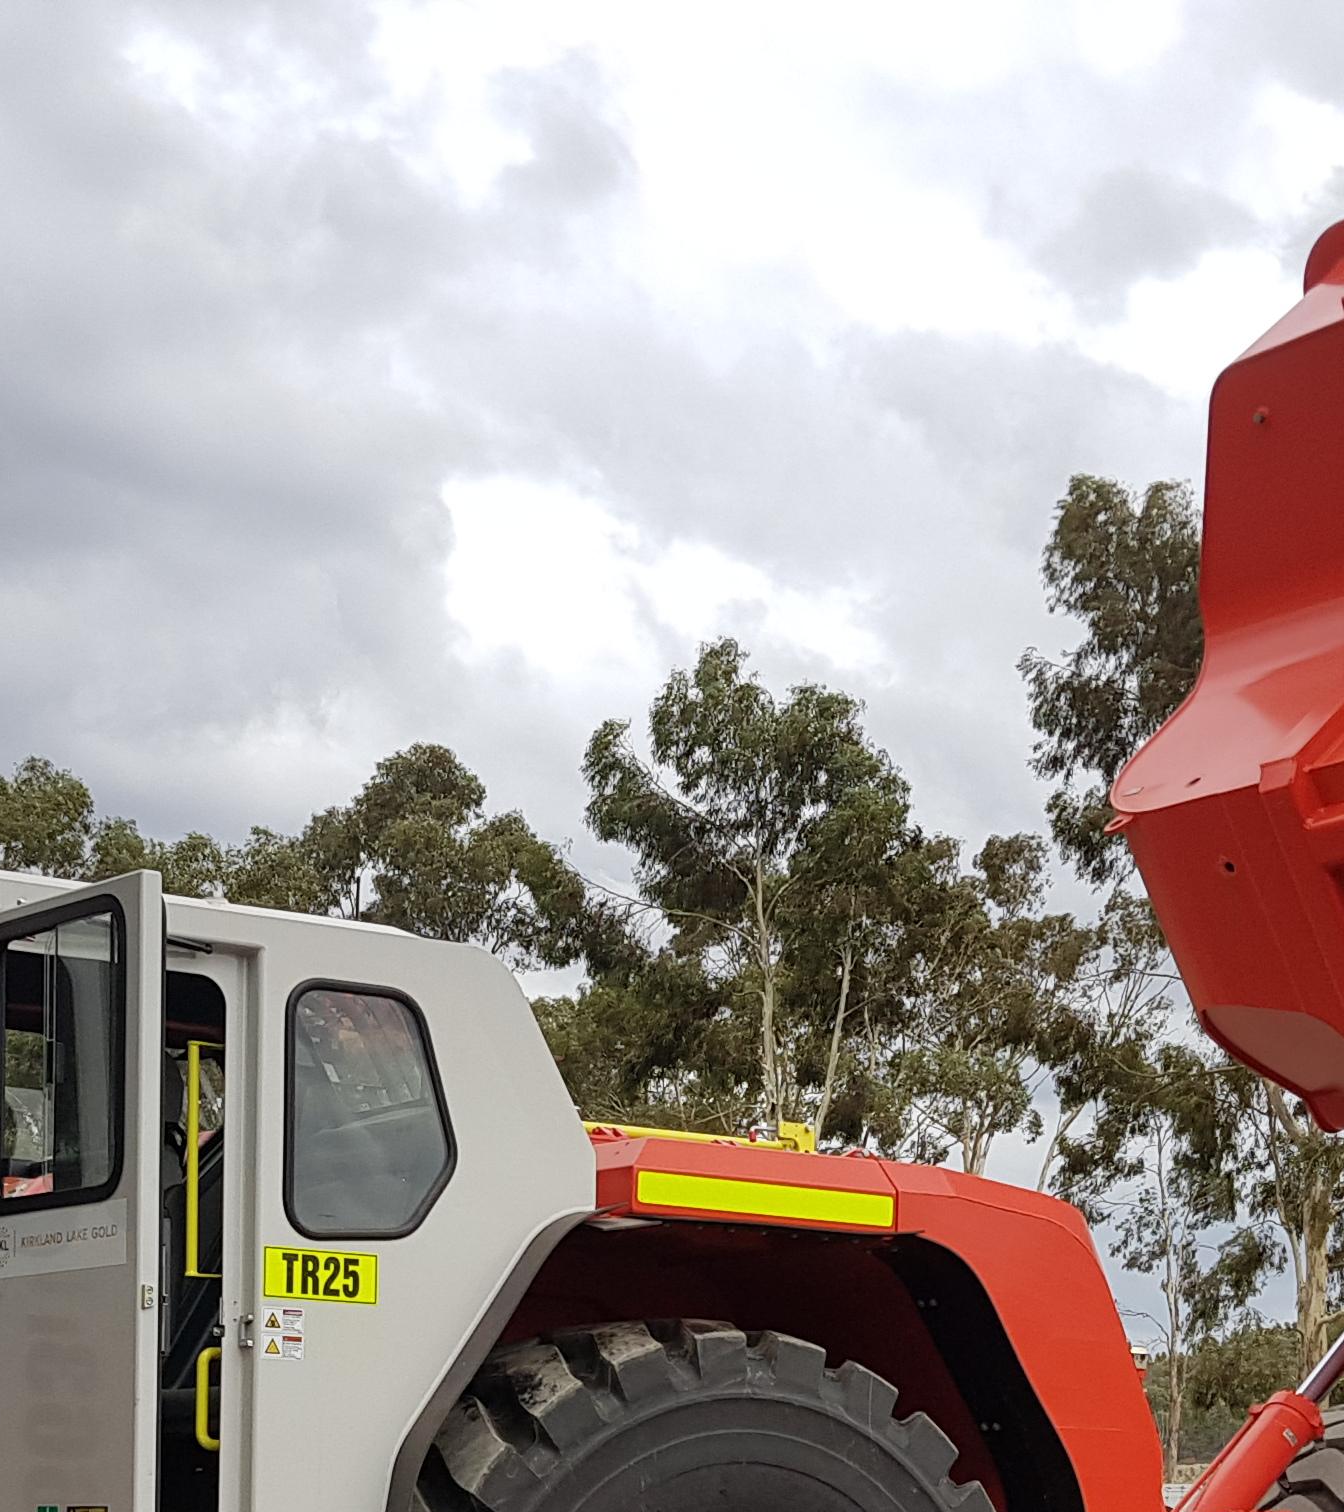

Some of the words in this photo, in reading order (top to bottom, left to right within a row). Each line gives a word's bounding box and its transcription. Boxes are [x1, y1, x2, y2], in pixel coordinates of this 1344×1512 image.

[20, 1231, 63, 1248] KIRKLAND
[67, 1228, 88, 1242] LAKE
[91, 1224, 117, 1239] GOLD
[282, 1252, 360, 1298] TR25
